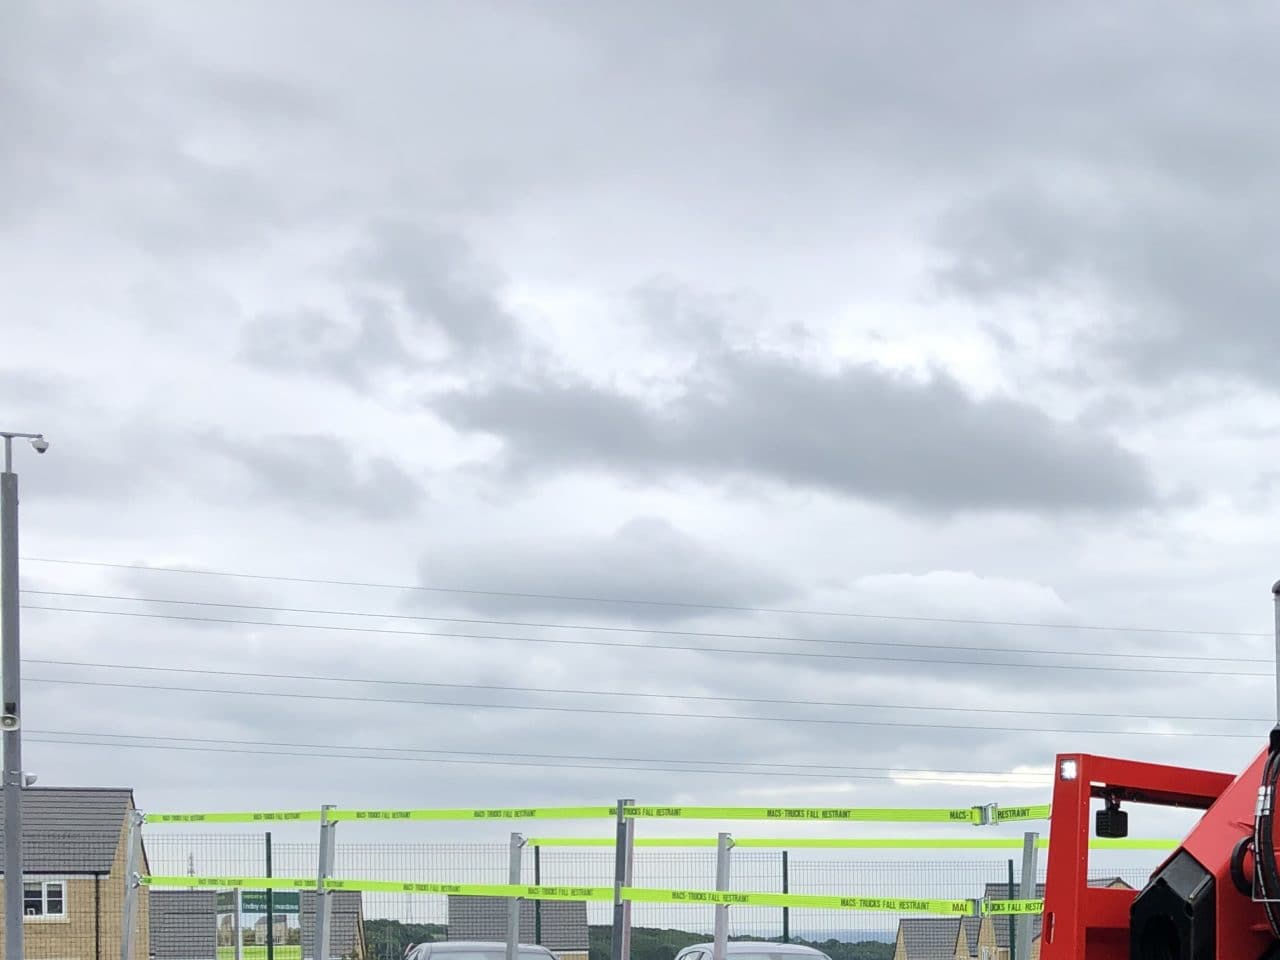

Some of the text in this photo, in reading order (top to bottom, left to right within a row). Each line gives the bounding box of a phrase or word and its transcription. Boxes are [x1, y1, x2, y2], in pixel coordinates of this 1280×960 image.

[806, 810, 819, 818] FALL
[822, 810, 851, 819] RESTRAINT
[997, 808, 1030, 820] RESTRAINT
[708, 893, 720, 902] FALL
[882, 900, 896, 909] FALL
[898, 901, 929, 910] RESTRAINT
[1007, 903, 1020, 912] FALL
